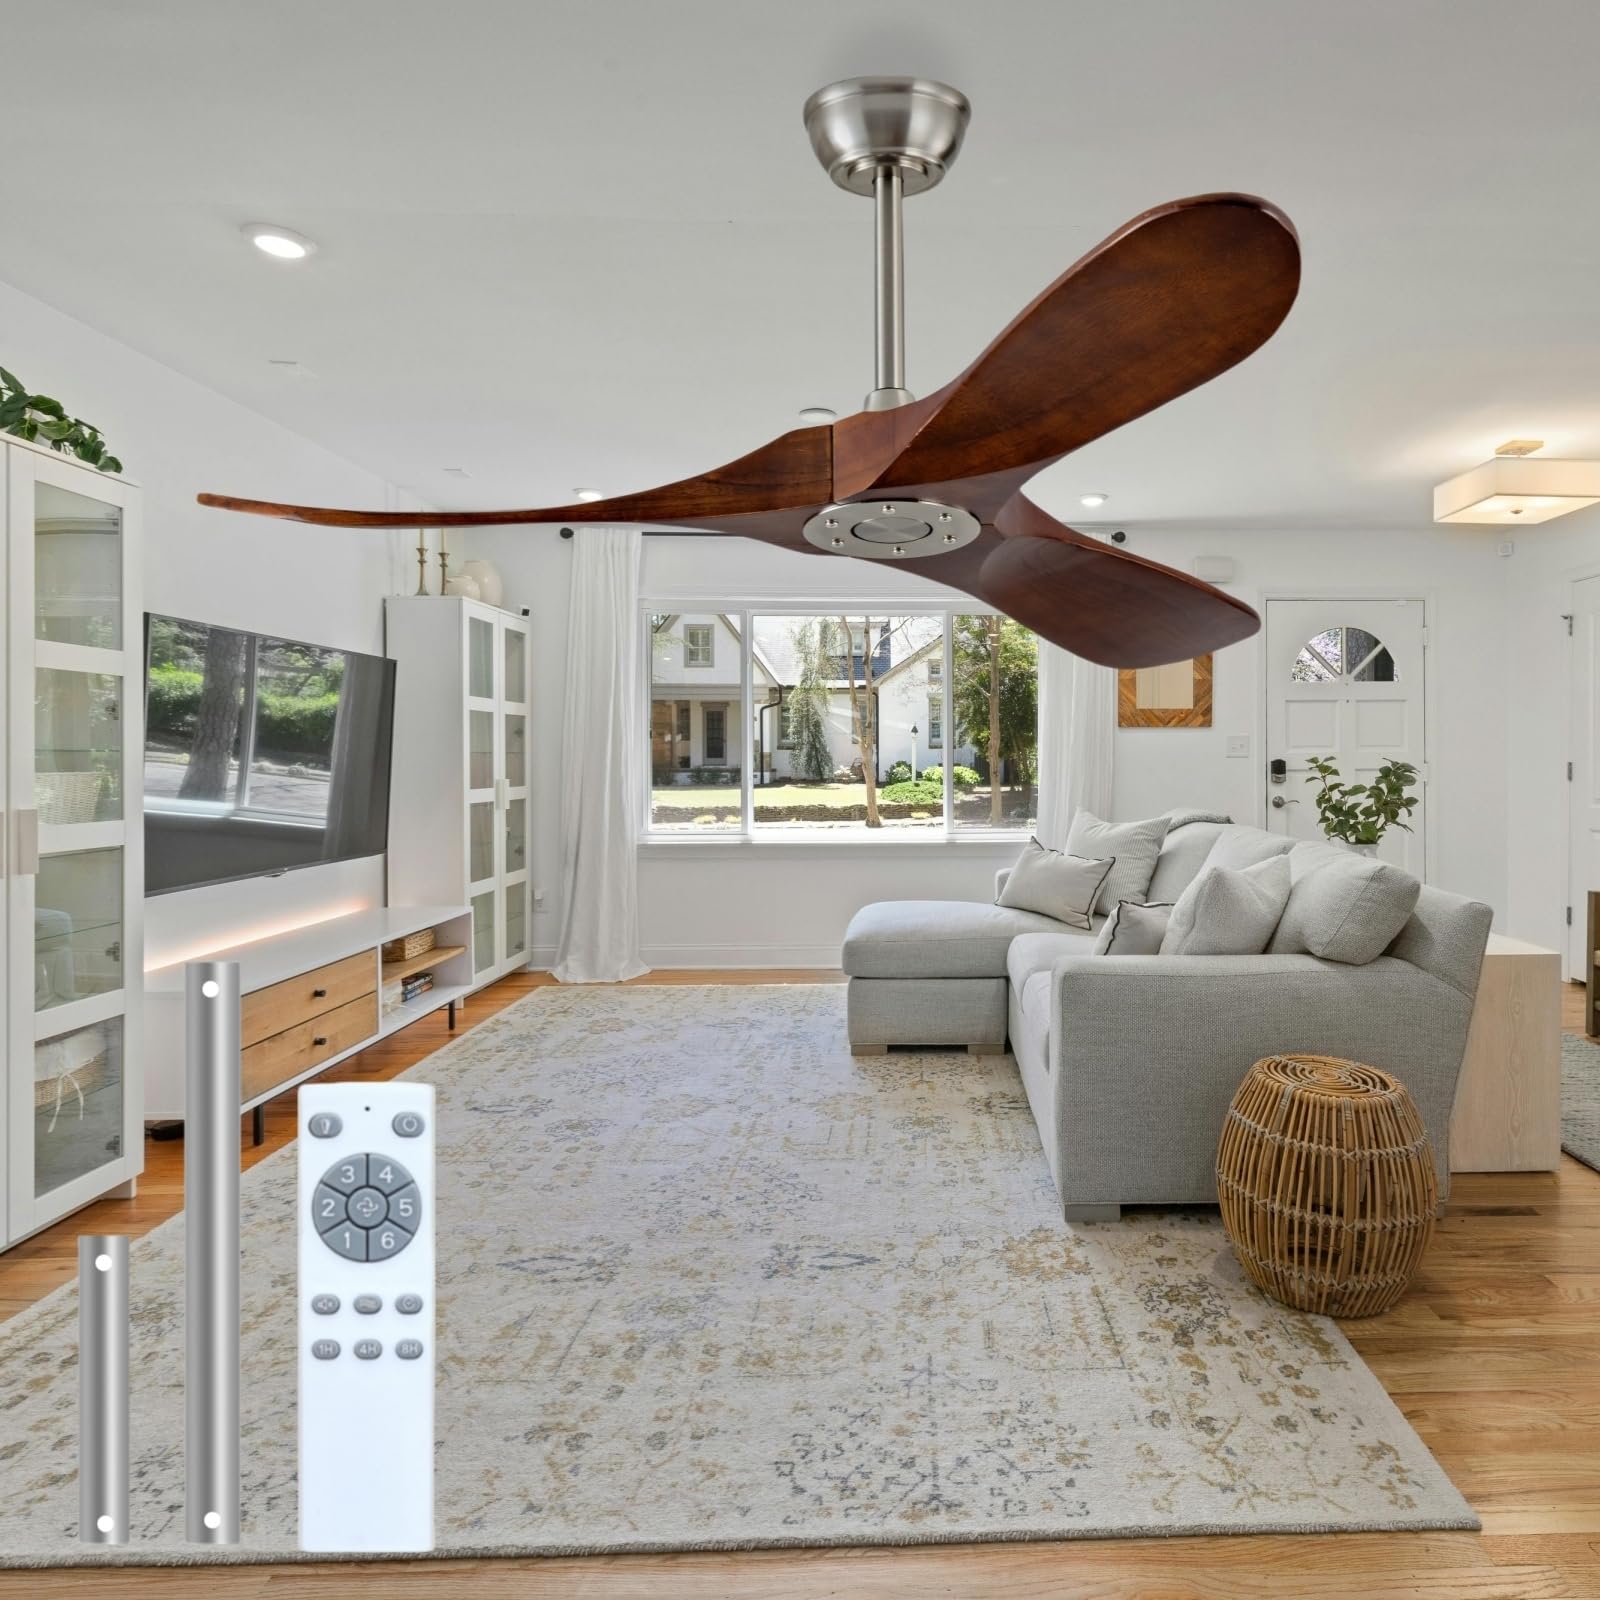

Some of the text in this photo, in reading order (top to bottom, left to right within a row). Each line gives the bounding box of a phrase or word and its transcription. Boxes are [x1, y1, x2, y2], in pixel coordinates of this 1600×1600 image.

[341, 1165, 355, 1183] 3
[379, 1165, 394, 1184] 4
[321, 1198, 336, 1217] 2
[399, 1198, 413, 1217] 5
[343, 1231, 350, 1249] 1
[381, 1231, 395, 1249] 6
[319, 1343, 333, 1355] 1H
[359, 1343, 377, 1355] 4H
[401, 1343, 418, 1355] 8H
